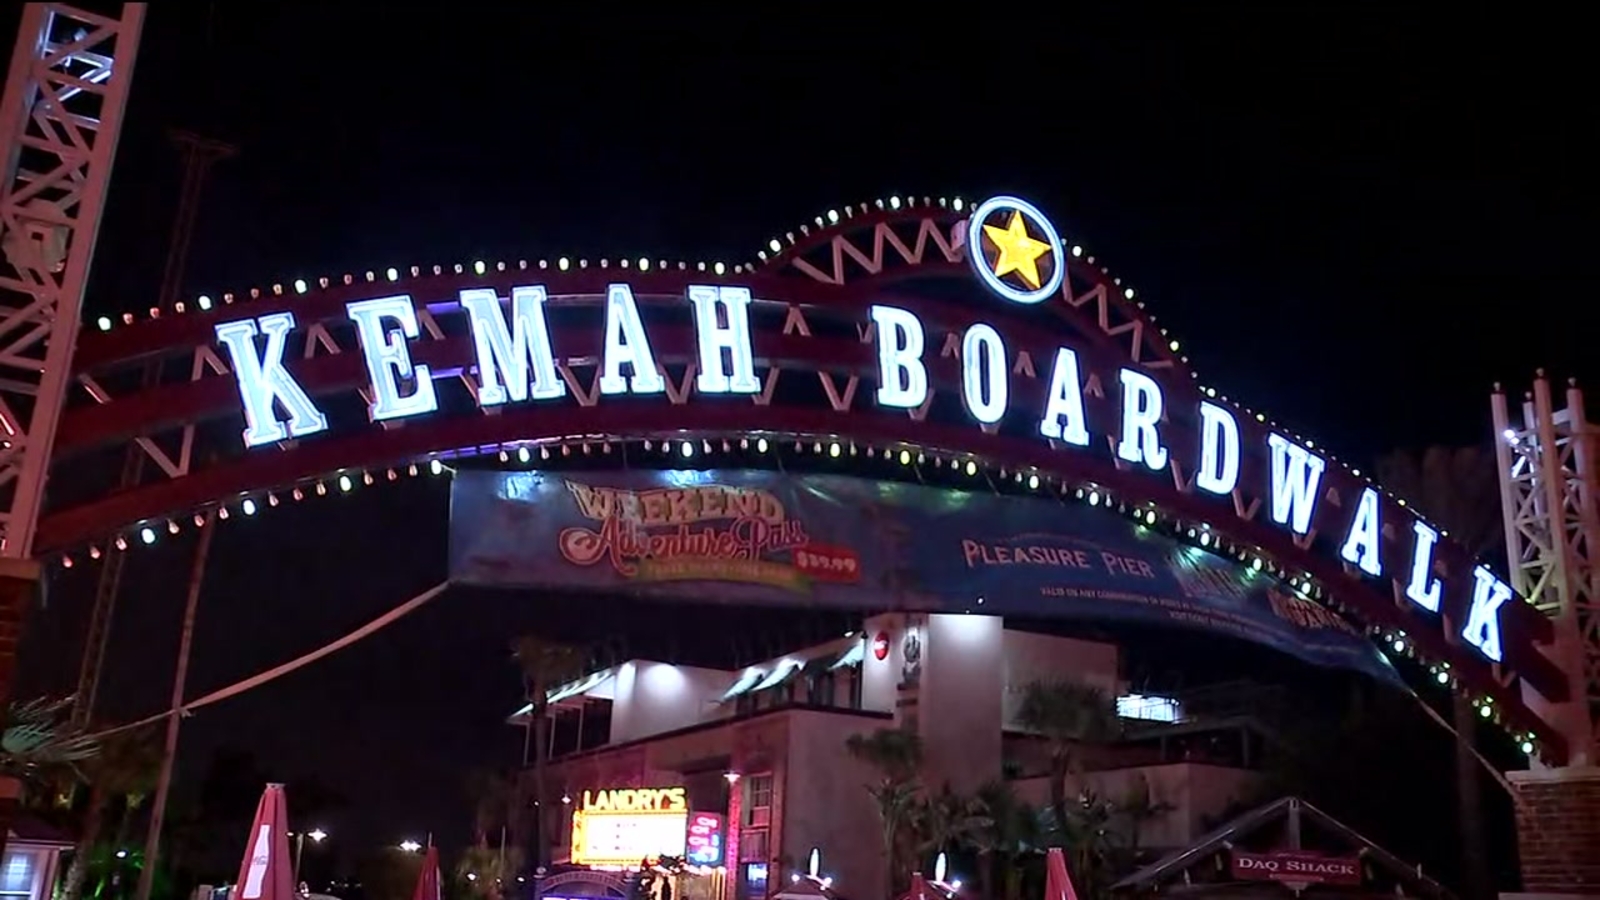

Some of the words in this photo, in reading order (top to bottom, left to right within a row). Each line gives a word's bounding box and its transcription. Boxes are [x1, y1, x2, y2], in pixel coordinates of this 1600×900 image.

[214, 283, 762, 448] KEMAH
[870, 304, 1513, 663] BOARDWALK
[564, 479, 784, 524] WEEKEND
[559, 514, 738, 576] Adventure
[730, 515, 809, 562] Pass
[961, 539, 1090, 569] PLEASURE
[1102, 551, 1155, 579] PIER
[583, 788, 686, 810] LANDRY'S
[1238, 858, 1279, 871] DAQ
[1286, 861, 1354, 875] SHACK
